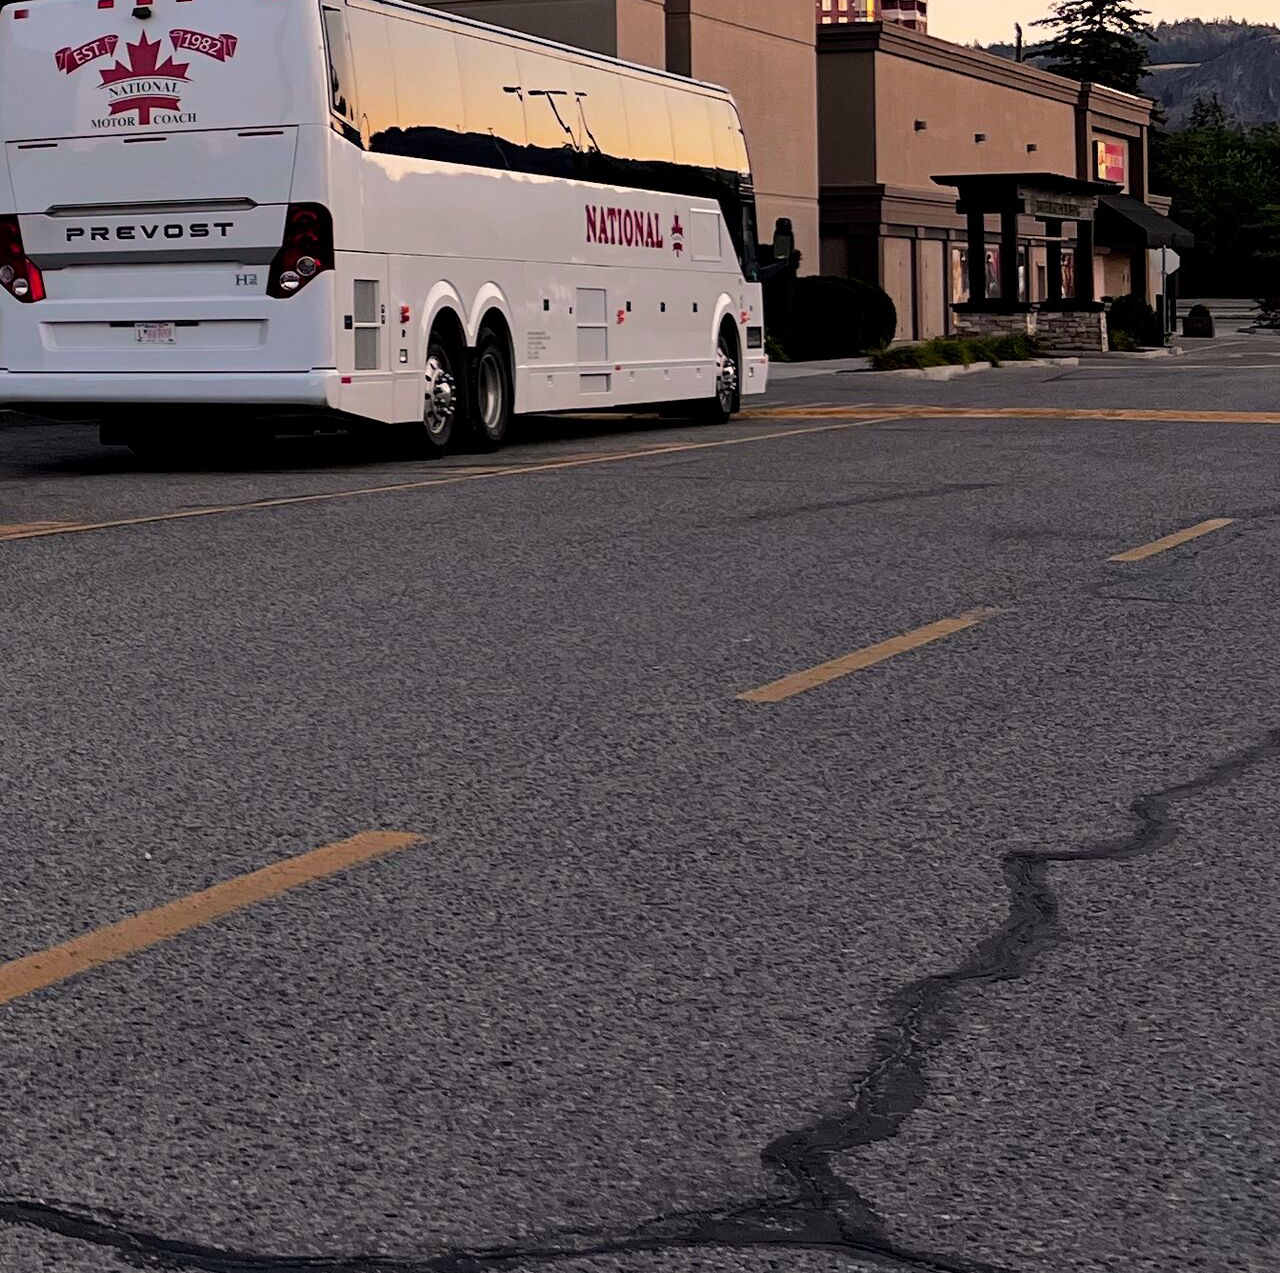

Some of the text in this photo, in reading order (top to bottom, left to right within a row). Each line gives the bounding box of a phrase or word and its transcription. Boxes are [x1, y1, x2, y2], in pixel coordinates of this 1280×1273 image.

[73, 41, 106, 65] EST.
[183, 33, 221, 56] 1982
[108, 80, 180, 98] NATIONAL
[91, 113, 197, 129] MOTOR COACH
[66, 222, 234, 241] PREVOST
[585, 204, 664, 249] NATIONAL
